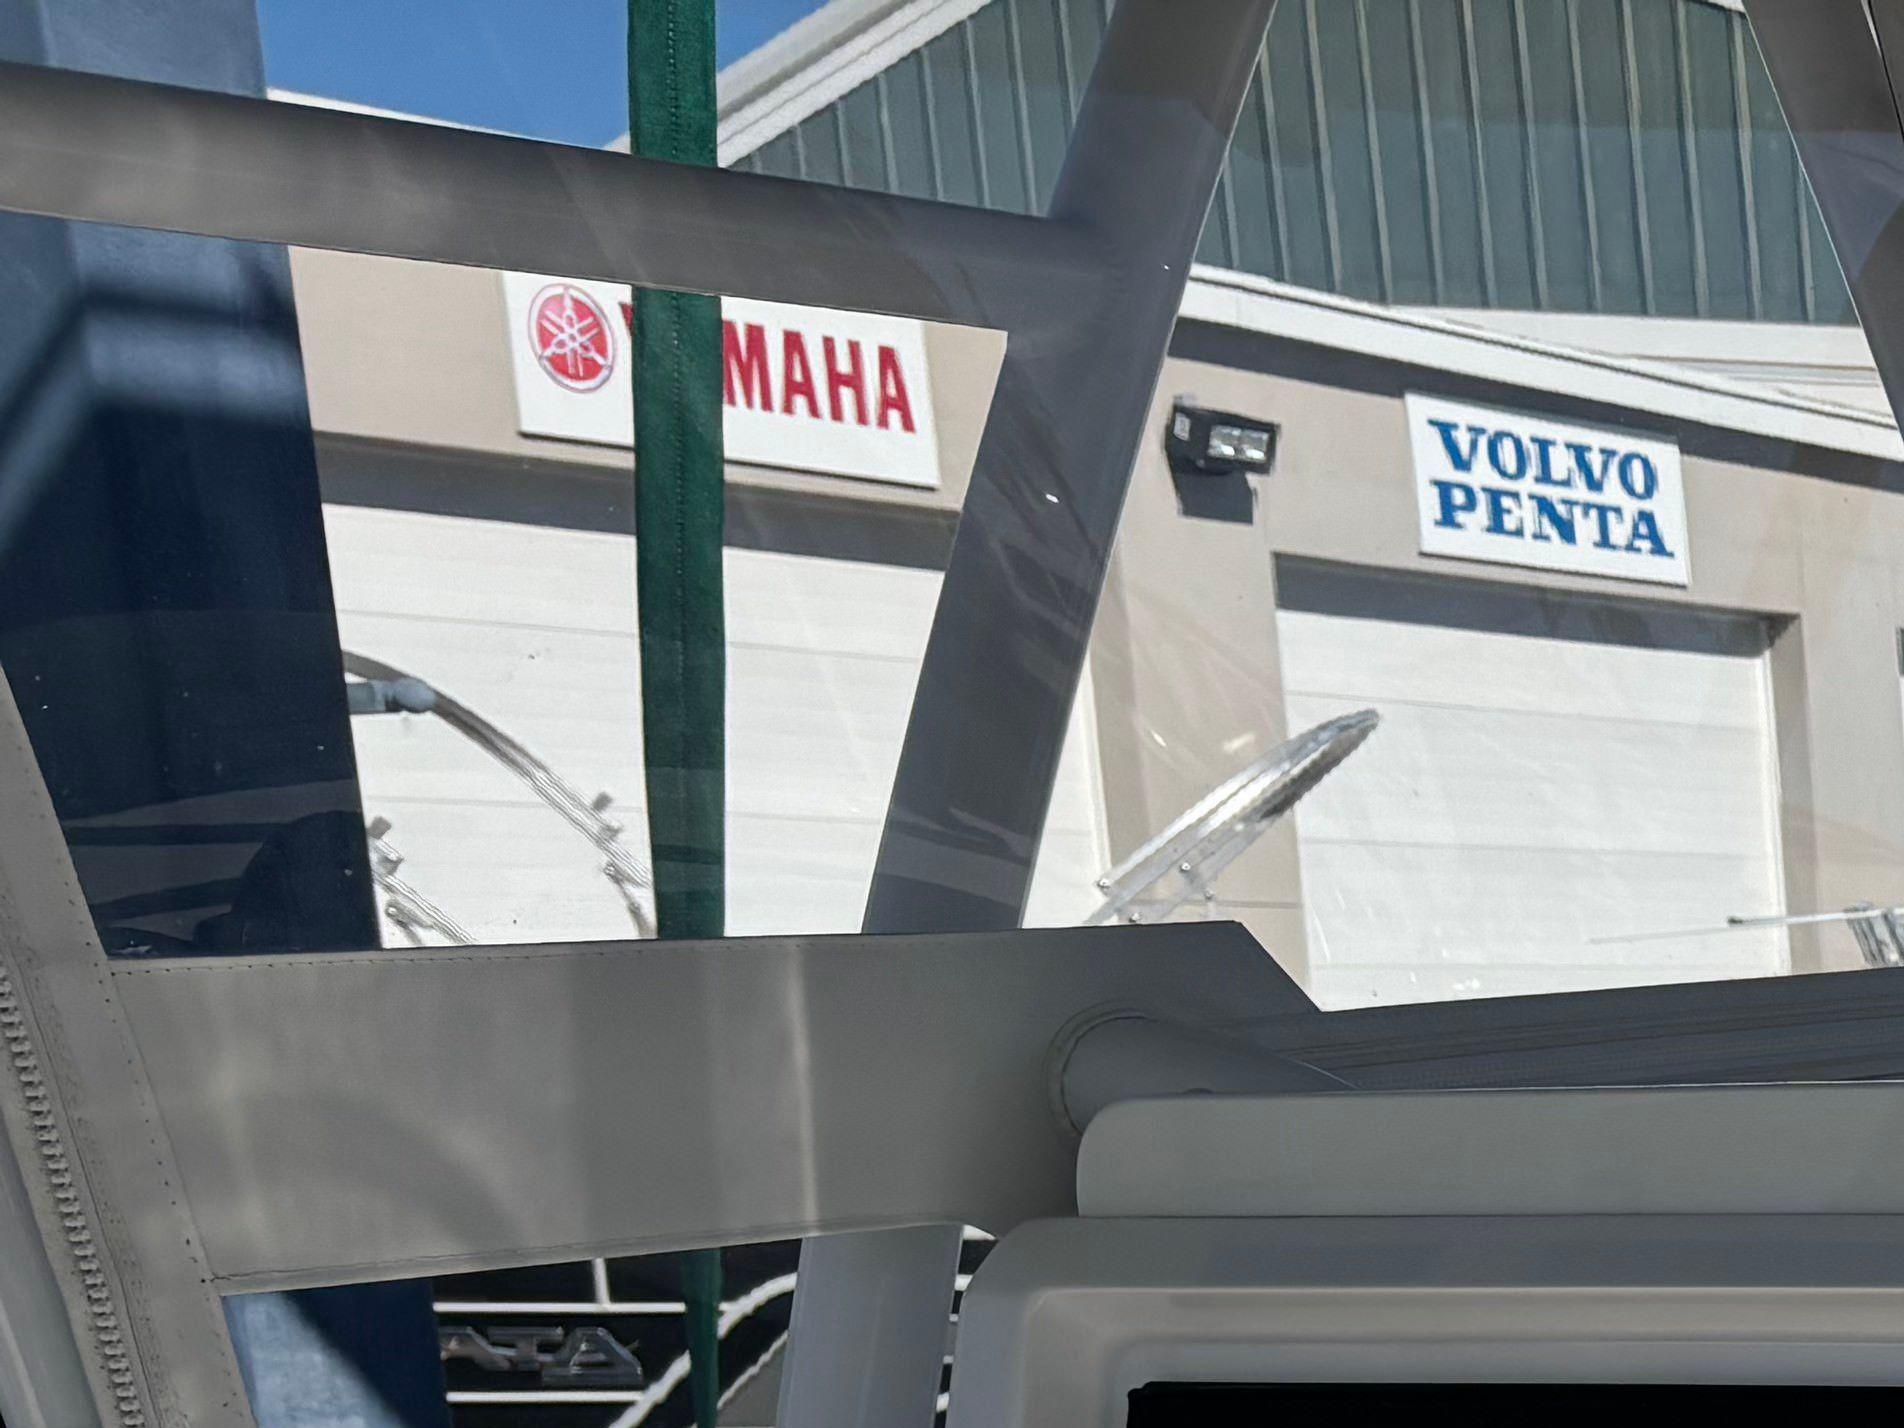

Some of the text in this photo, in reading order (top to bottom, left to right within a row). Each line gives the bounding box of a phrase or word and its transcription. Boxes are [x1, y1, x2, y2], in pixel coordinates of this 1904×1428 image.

[619, 302, 916, 434] MAHA
[1426, 418, 1658, 501] VOLVO
[1429, 479, 1676, 559] PENTA
